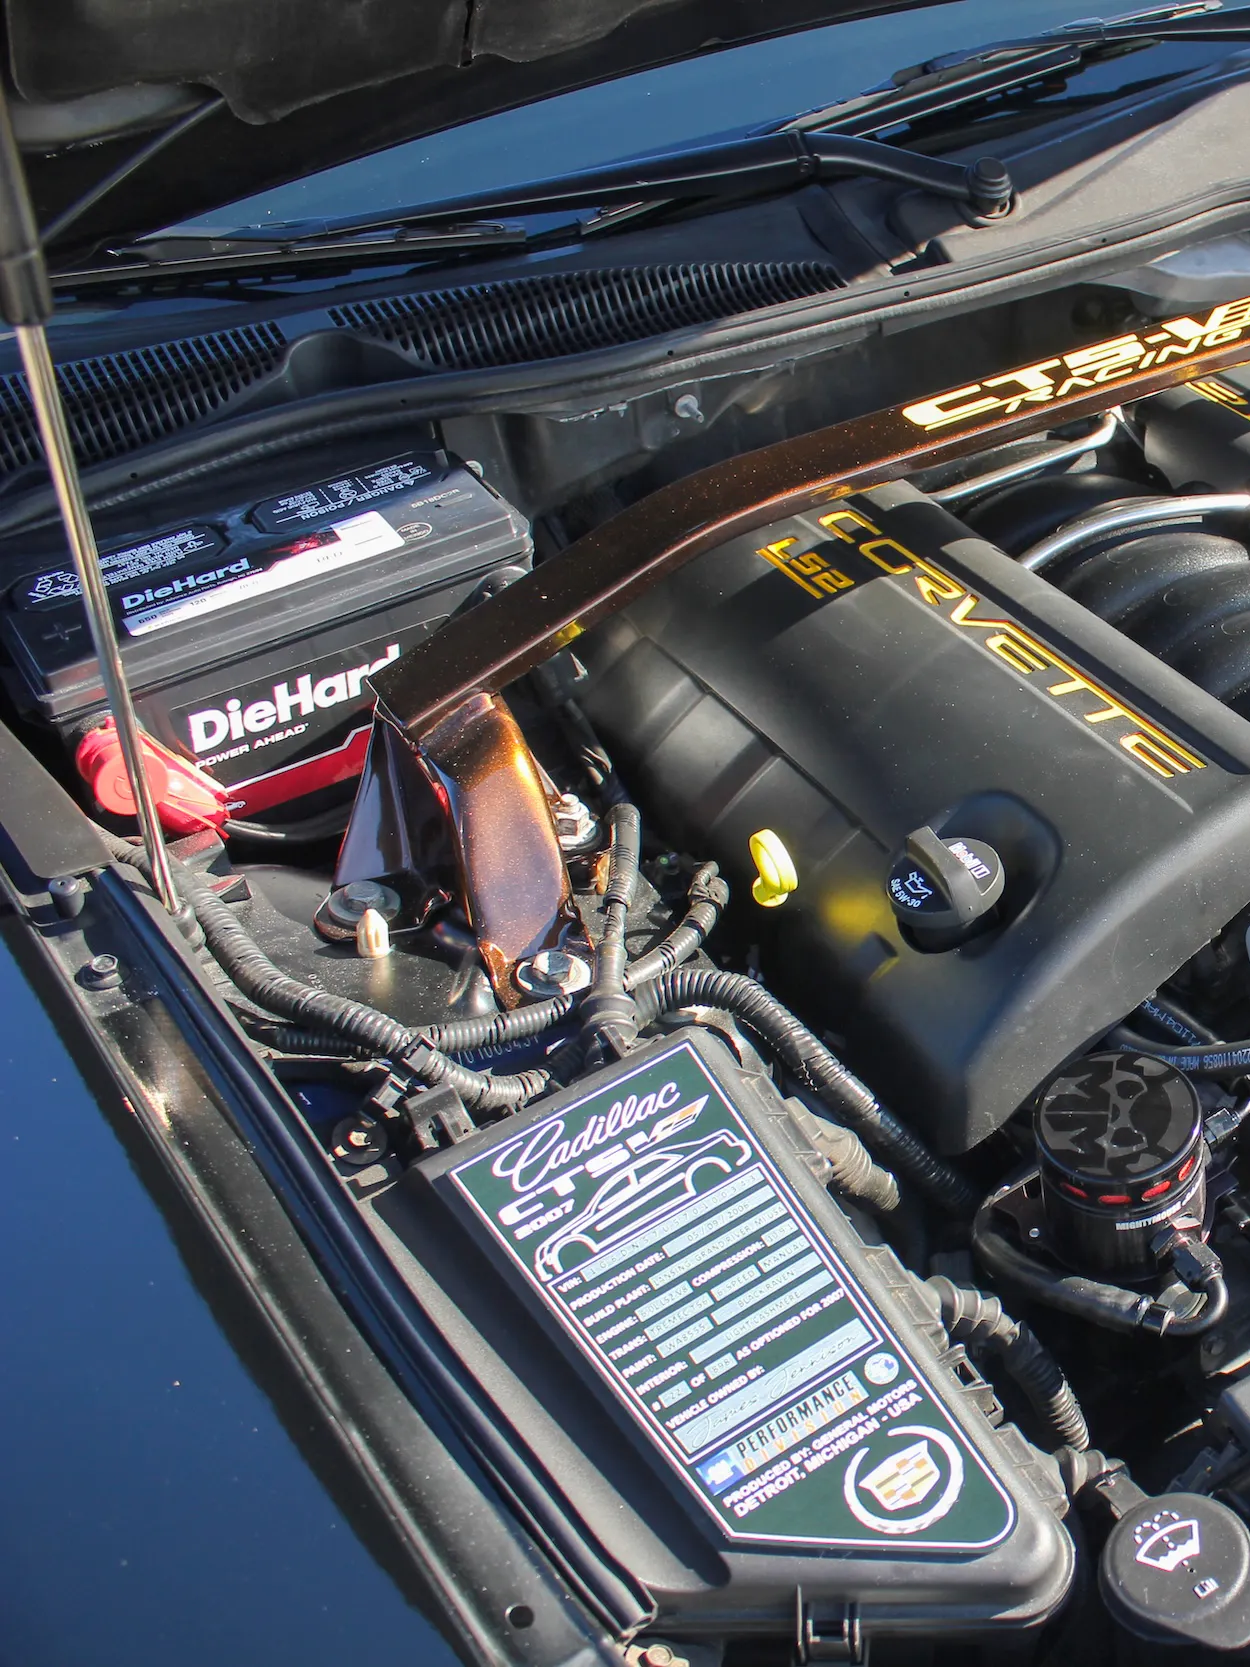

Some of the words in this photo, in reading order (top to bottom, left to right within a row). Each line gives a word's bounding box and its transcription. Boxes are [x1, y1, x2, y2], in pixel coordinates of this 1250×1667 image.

[1005, 328, 1241, 413] RACING
[299, 502, 345, 520] POISON
[355, 483, 405, 502] DANGER
[118, 557, 253, 609] DieHard
[756, 535, 854, 597] LS2
[819, 510, 1207, 778] CORVETTE
[194, 742, 251, 770] POWER
[890, 878, 903, 893] SAE
[948, 841, 979, 872] Mobil
[895, 890, 921, 908] 5W-30
[492, 1082, 681, 1193] Cadillac
[512, 1196, 578, 1242] 2007
[557, 1275, 582, 1294] VIN:
[569, 1267, 637, 1312] PRODUCTION
[634, 1249, 666, 1273] DATE:
[582, 1303, 616, 1327] BUILD
[613, 1281, 651, 1309] PLANT:
[595, 1314, 639, 1345] ENGINE:
[690, 1238, 765, 1288] COMPRESSION:
[608, 1333, 647, 1361] TRANS:
[762, 1239, 805, 1269] MANUAL
[621, 1352, 657, 1378] PAINT:
[736, 1287, 765, 1308] BLACK
[764, 1268, 795, 1291] RAVEN
[635, 1359, 688, 1395] INTERIOR:
[751, 1290, 801, 1324] CASHMERE
[689, 1372, 707, 1388] OF
[734, 1345, 752, 1360] AS
[749, 1315, 802, 1351] OPTIONED
[799, 1302, 823, 1321] FOR
[820, 1287, 846, 1308] 2007
[665, 1398, 709, 1430] VEHICLE
[706, 1374, 749, 1405] OWNED
[746, 1364, 765, 1380] BY:
[733, 1375, 856, 1458] PERFORMANCE
[741, 1389, 865, 1471] DIVISION
[721, 1459, 793, 1507] PRODUCED
[790, 1445, 813, 1465] BY:
[810, 1410, 869, 1451] GENERAL
[863, 1377, 919, 1414] MOTORS
[732, 1467, 807, 1517] DETROIT,
[803, 1417, 882, 1472] MICHIGAN
[886, 1389, 924, 1418] USA
